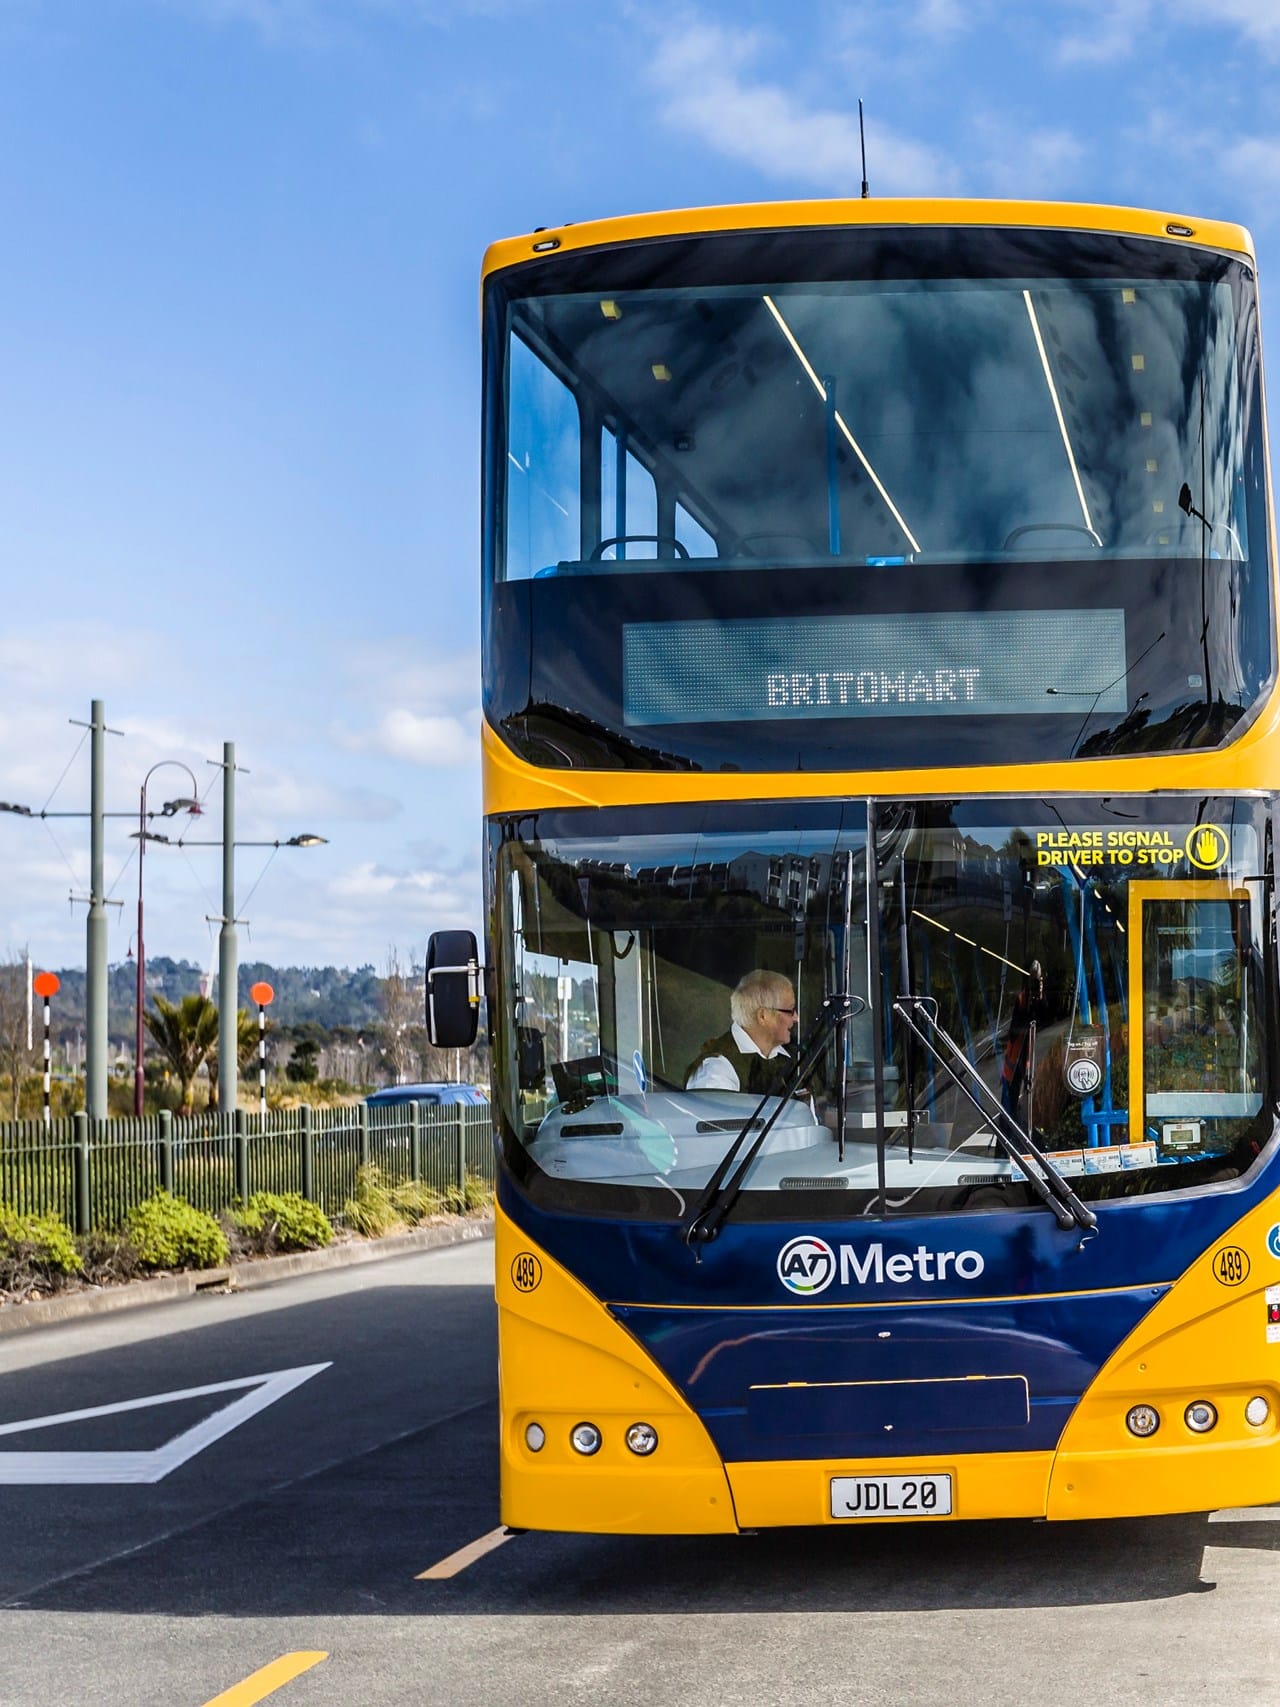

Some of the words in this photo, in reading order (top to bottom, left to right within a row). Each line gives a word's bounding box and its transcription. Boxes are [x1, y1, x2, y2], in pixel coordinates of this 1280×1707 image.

[767, 668, 980, 706] BRITOMART
[1036, 832, 1103, 848] PLEASE
[1107, 831, 1174, 846] SIGNAL
[1037, 850, 1104, 866] DRIVER
[1106, 849, 1134, 865] TO
[1137, 848, 1184, 864] STOP
[516, 1257, 535, 1287] 489
[839, 1242, 985, 1285] Metro
[1220, 1250, 1242, 1281] 489
[845, 1482, 937, 1511] JDL20
